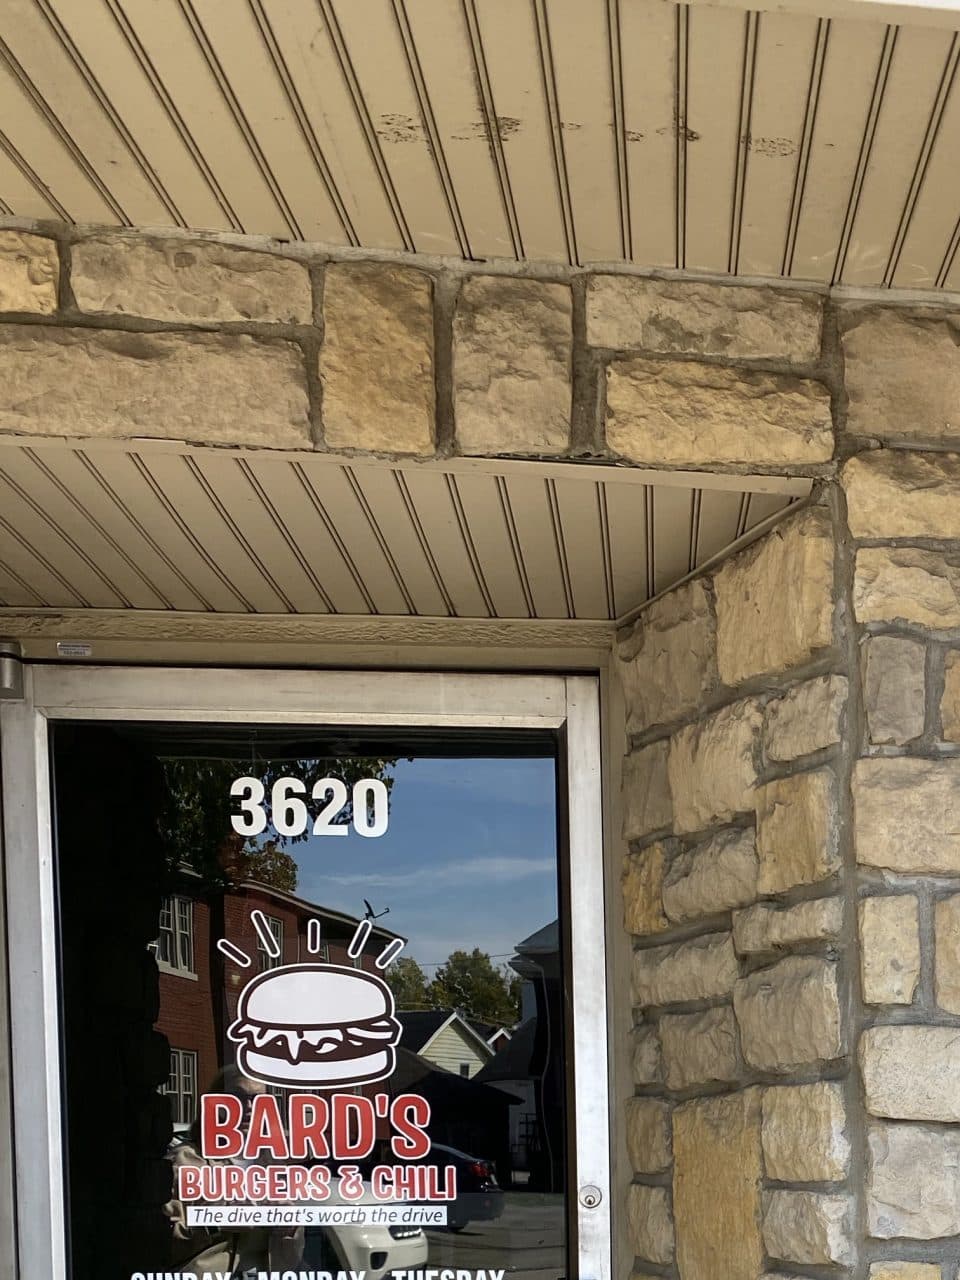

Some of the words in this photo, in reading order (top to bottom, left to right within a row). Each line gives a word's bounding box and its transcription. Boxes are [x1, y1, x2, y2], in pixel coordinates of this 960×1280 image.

[229, 776, 390, 837] 3620
[201, 1094, 431, 1160] BARD'S
[179, 1165, 331, 1201] BURGERS
[338, 1165, 363, 1200] &
[371, 1165, 457, 1200] CHILI
[194, 1208, 223, 1224] The
[227, 1208, 262, 1223] dive
[267, 1207, 313, 1223] that's
[319, 1207, 367, 1223] worth
[372, 1207, 397, 1222] the
[402, 1207, 443, 1223] drive
